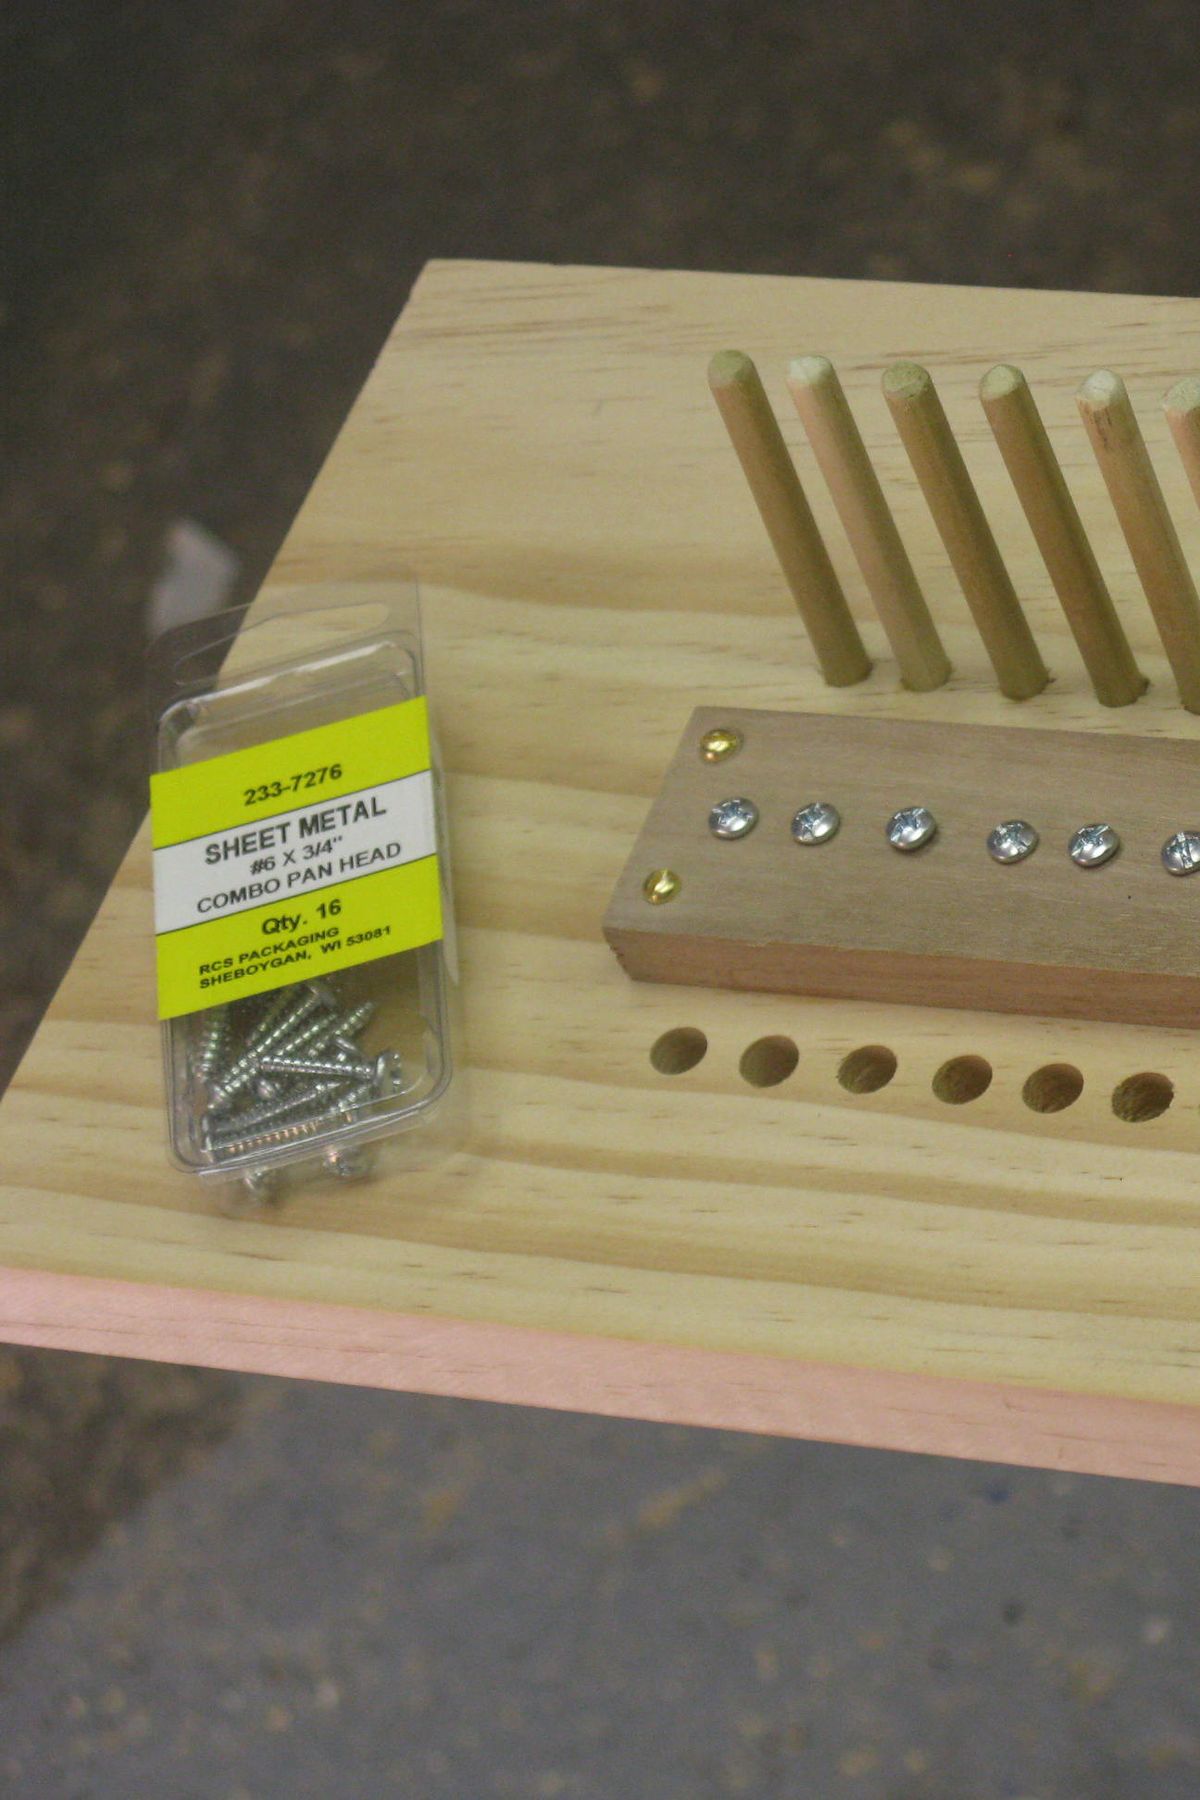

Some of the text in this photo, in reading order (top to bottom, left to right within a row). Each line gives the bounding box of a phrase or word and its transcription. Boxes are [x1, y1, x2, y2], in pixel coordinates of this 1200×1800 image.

[243, 763, 343, 807] 233-7276
[204, 796, 387, 865] SHEET METAL
[196, 841, 402, 914] COMBO PAN HEAD
[249, 855, 276, 876] #6
[282, 849, 297, 866] X
[261, 898, 342, 938] Qty. 16
[198, 926, 340, 977] RCS PACKAGING
[198, 924, 392, 990] SHEBOYGAN, WI 53081
